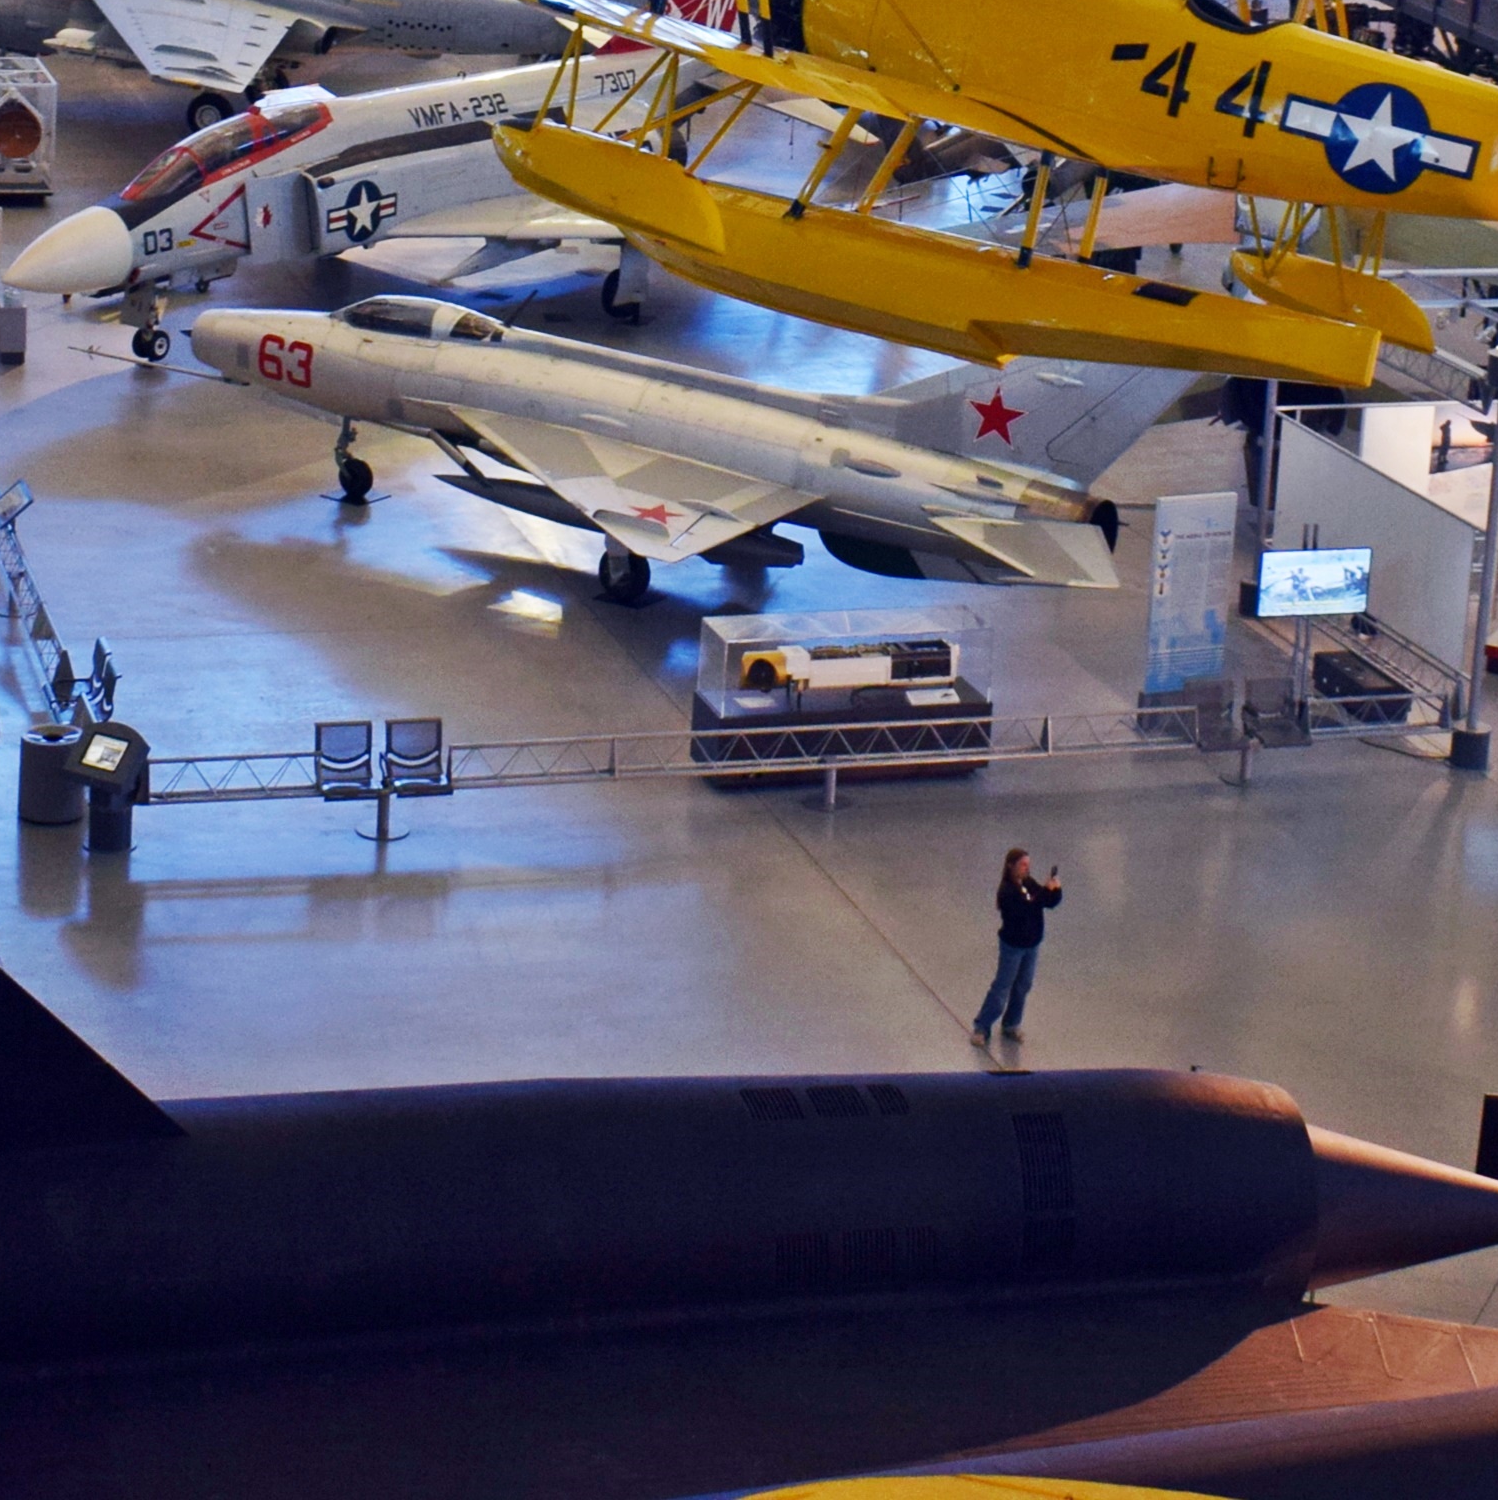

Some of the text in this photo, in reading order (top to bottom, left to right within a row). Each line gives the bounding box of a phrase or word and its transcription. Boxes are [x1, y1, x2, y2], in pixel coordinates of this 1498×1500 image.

[594, 69, 637, 95] 7307
[407, 92, 510, 128] VMFA-232
[143, 228, 174, 255] 03
[258, 334, 314, 389] 63
